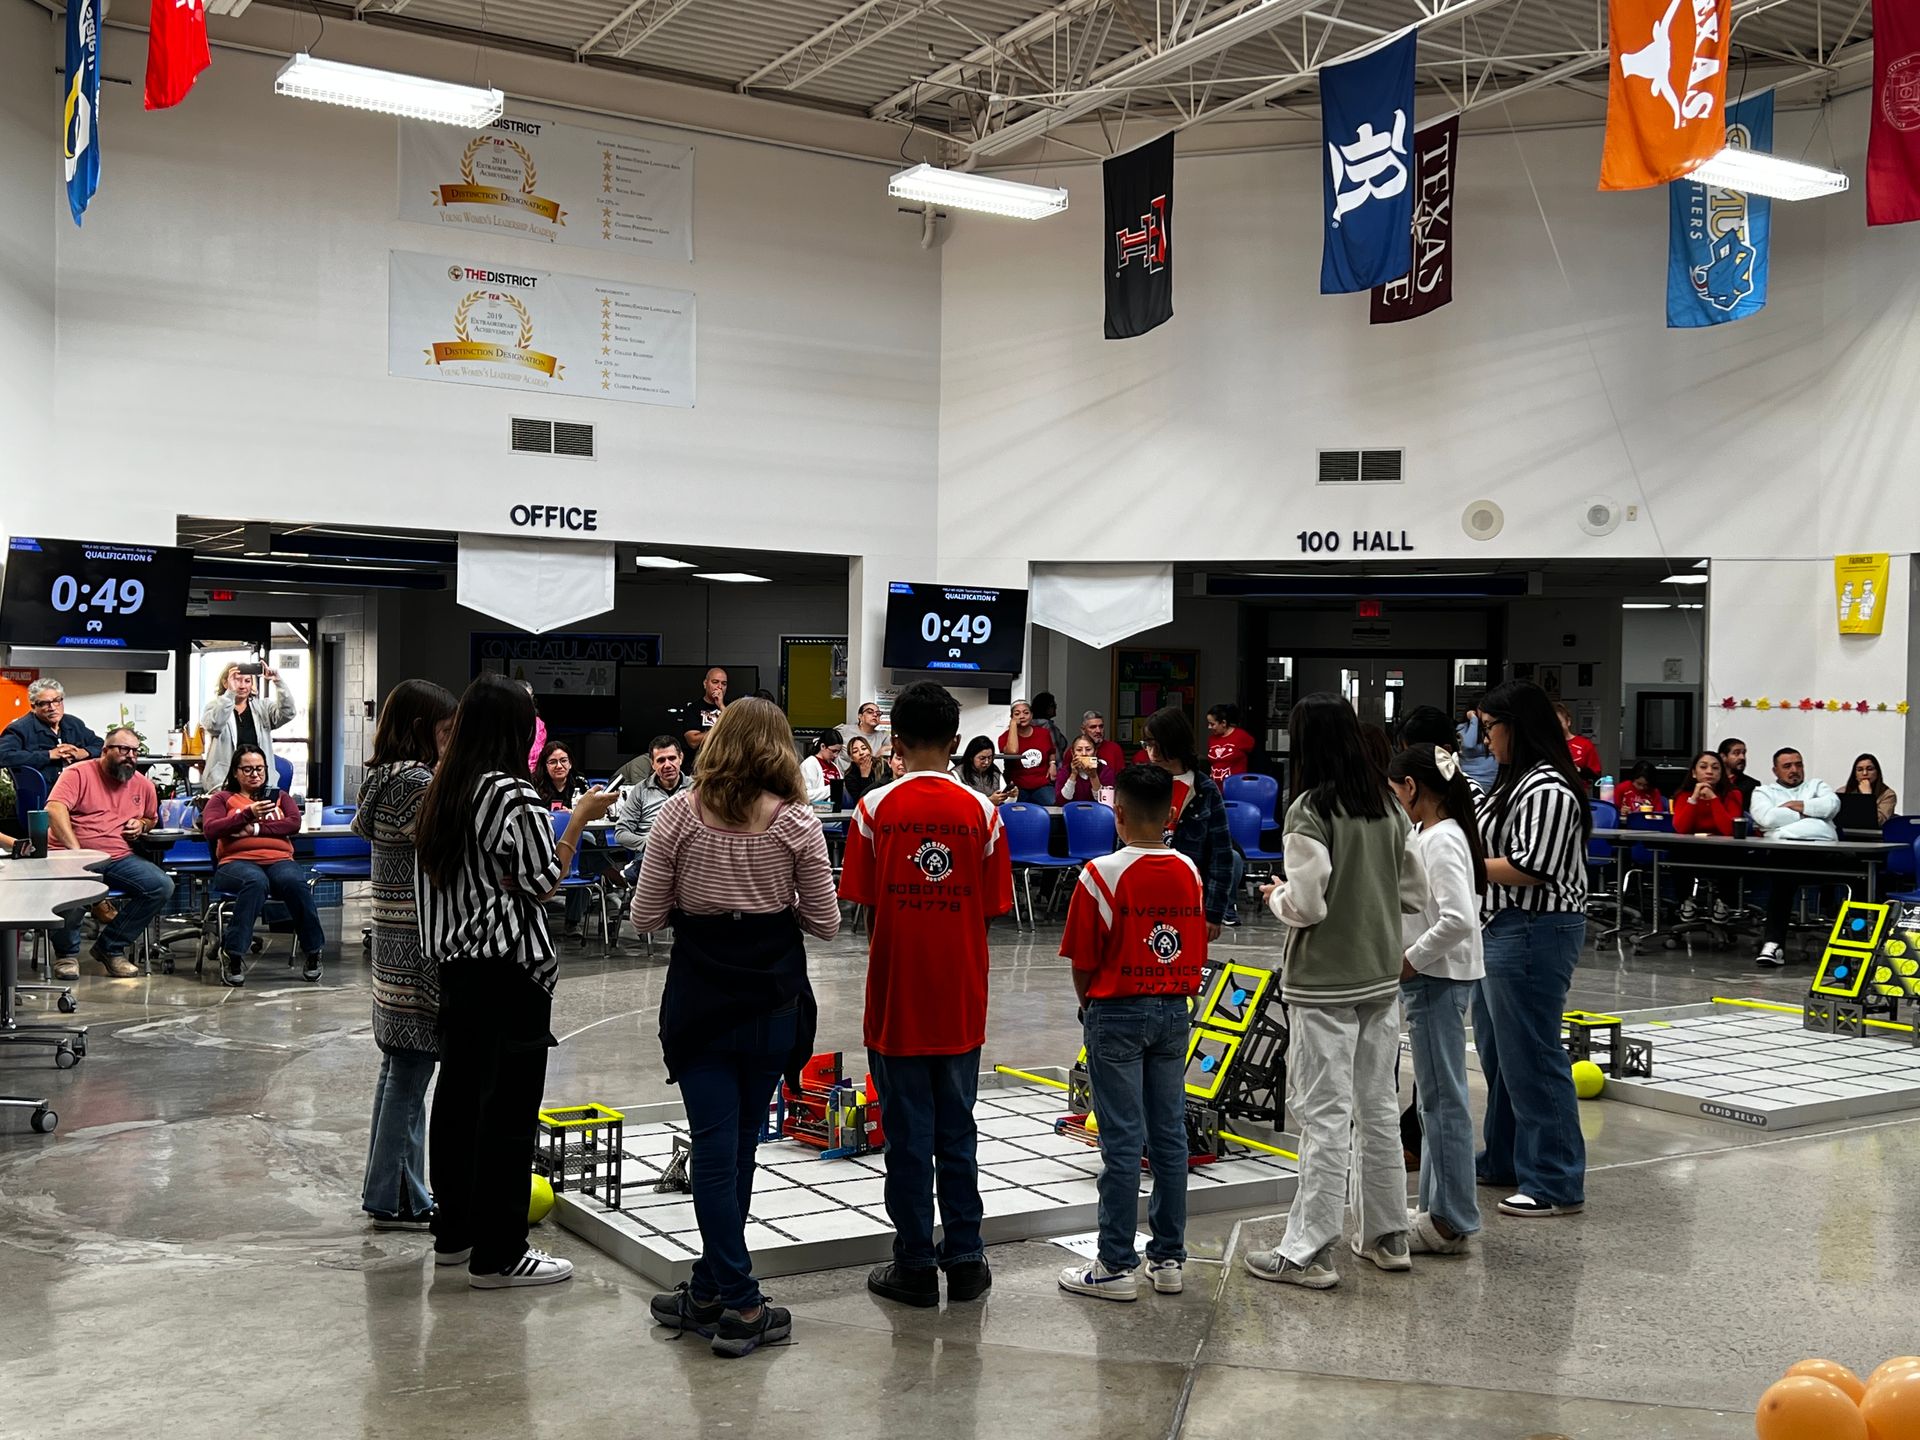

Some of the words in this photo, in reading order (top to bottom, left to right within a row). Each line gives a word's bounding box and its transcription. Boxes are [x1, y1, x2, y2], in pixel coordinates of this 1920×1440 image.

[1681, 0, 1720, 119] EXAS
[488, 118, 541, 135] DISTRICT
[491, 156, 507, 165] 2018
[1416, 131, 1450, 294] TEXAS
[1690, 184, 1703, 240] TLERS
[486, 311, 503, 320] 2019
[444, 347, 494, 357] DISTINCTION
[495, 348, 546, 367] DESIGNATION
[510, 504, 598, 531] OFFICE
[1297, 530, 1339, 552] 100
[1353, 530, 1414, 551] HALL
[85, 551, 146, 562] QUALIFICATION
[146, 554, 153, 562] 6
[51, 574, 145, 615] 0:49
[945, 592, 991, 601] QUALIFICATION
[921, 612, 992, 644] 0:49
[65, 637, 88, 645] DRIVER
[89, 638, 119, 646] CONTROL
[897, 901, 962, 913] 74778
[1121, 965, 1200, 977] ROBOTICS
[1135, 981, 1191, 993] 74778
[1703, 1104, 1731, 1117] RAPID
[1734, 1112, 1764, 1124] RELAY
